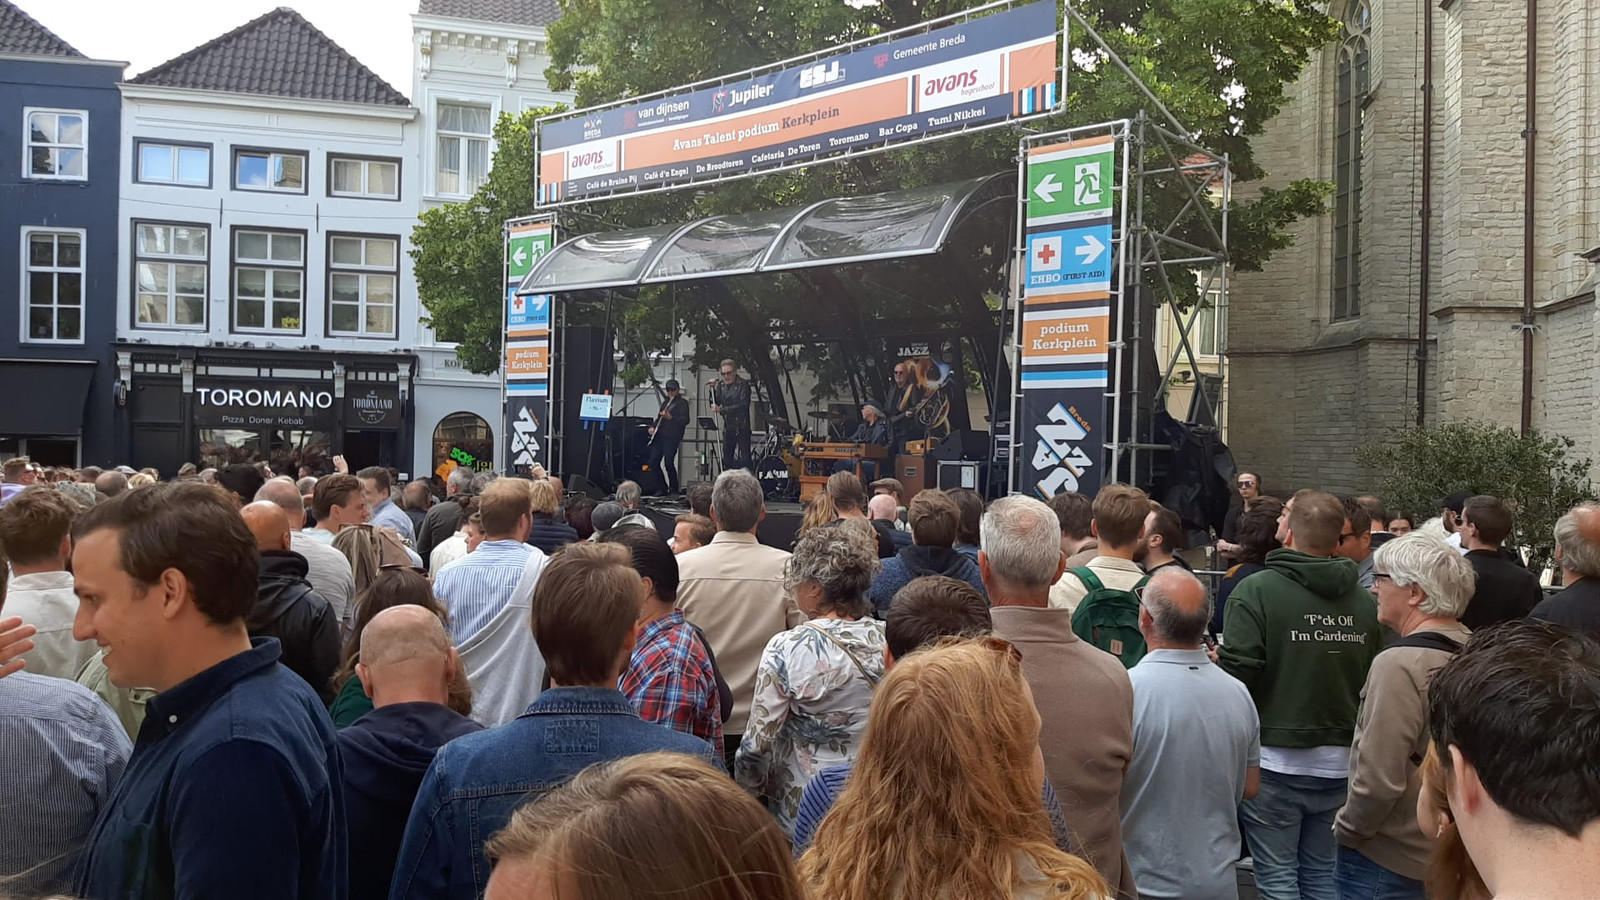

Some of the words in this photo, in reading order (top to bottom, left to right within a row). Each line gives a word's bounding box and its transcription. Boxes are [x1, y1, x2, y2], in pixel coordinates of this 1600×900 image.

[893, 44, 937, 60] Gemeente
[939, 33, 966, 49] Breda
[799, 61, 839, 88] ESJ
[924, 69, 978, 96] avans
[728, 84, 774, 107] Jupiler
[961, 82, 996, 96] hogeschool
[638, 108, 654, 119] van
[656, 101, 690, 116] dijnsen
[928, 115, 953, 129] Tumi
[953, 105, 987, 123] Nikkei
[584, 129, 602, 139] BREDA
[673, 139, 703, 151] Avans
[704, 128, 736, 146] Talent
[738, 122, 780, 142] podium
[781, 107, 840, 130] Kerkplein
[878, 128, 895, 137] Bar
[896, 121, 919, 134] Copa
[829, 132, 870, 148] Toromano
[571, 150, 603, 168] avans
[751, 150, 786, 165] Cafetaria
[787, 147, 799, 157] De
[799, 142, 822, 155] Toren
[644, 172, 660, 181] Café
[671, 165, 690, 178] Engel
[696, 164, 706, 174] De
[707, 158, 745, 172] Broodtoren
[586, 180, 600, 190] Café
[601, 179, 608, 187] de
[609, 175, 629, 187] Bruine
[1030, 272, 1062, 285] EHBO
[1062, 270, 1088, 281] (FIRST
[1088, 269, 1106, 278] AID)
[1040, 322, 1090, 339] podium
[897, 346, 930, 357] JAZZ
[1032, 337, 1098, 353] Kerkplein
[515, 351, 540, 361] podium
[511, 360, 543, 371] Kerkplein
[196, 387, 333, 409] TOROMANO
[352, 397, 393, 410] TOROMANO
[221, 414, 245, 424] Pizza
[248, 415, 274, 425] Doner
[277, 416, 305, 426] Kebab
[1067, 405, 1093, 433] Breda
[1338, 615, 1354, 627] Off
[1291, 630, 1311, 641] I'm
